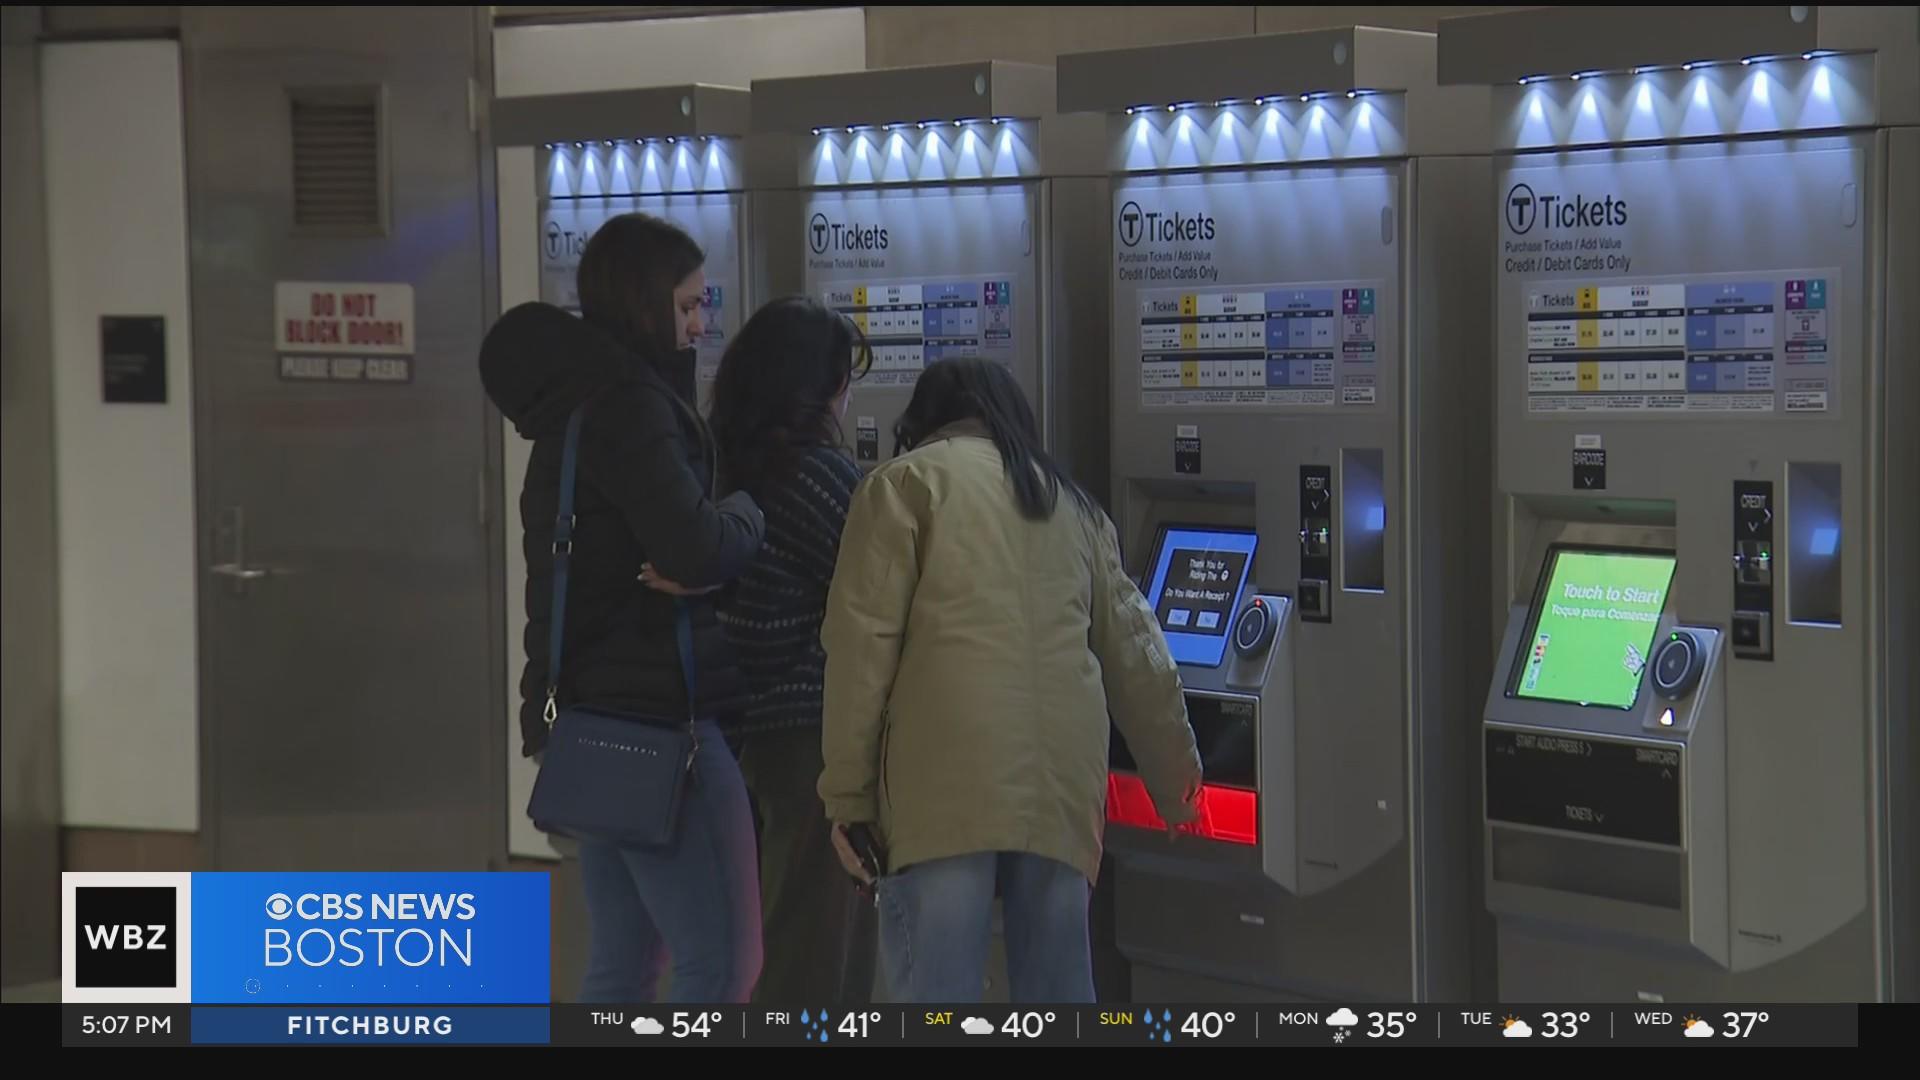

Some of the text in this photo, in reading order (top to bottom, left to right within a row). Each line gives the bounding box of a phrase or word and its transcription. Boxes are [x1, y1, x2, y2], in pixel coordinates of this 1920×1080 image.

[1539, 194, 1628, 229] Tickets
[1145, 211, 1216, 242] Tickets
[831, 222, 889, 251] Tickets
[1504, 241, 1542, 253] Purchase
[1544, 239, 1573, 252] Tickets
[1580, 238, 1597, 250] Add
[1599, 237, 1622, 250] Value
[1149, 251, 1173, 262] Tickets
[1178, 251, 1192, 261] Add
[1193, 250, 1212, 261] Value
[1505, 257, 1536, 273] Credit
[1544, 256, 1572, 272] Debit
[1573, 255, 1605, 271] Cards
[1606, 253, 1631, 273] Only
[1118, 268, 1144, 281] Credit
[1149, 267, 1172, 280] Debit
[1172, 265, 1198, 280] Cards
[1198, 265, 1219, 282] Only
[311, 293, 376, 317] DO NOT
[1152, 301, 1179, 312] Tickets
[1542, 293, 1575, 307] Tickets
[286, 319, 403, 345] BLOCK DOOR!
[1574, 452, 1604, 466] BARCODE
[1740, 494, 1766, 508] CREDIT
[1189, 558, 1205, 569] Thank
[1206, 560, 1216, 569] You
[1207, 571, 1218, 582] The
[1165, 587, 1174, 597] Do
[1175, 588, 1184, 598] You
[1185, 589, 1200, 599] Want
[1200, 590, 1205, 599] A
[1563, 583, 1660, 604] Touch to Start
[1551, 604, 1581, 620] Toque
[1582, 607, 1606, 620] para
[1516, 733, 1536, 748] START
[1536, 737, 1556, 751] AUDIO
[1557, 739, 1578, 754] PRESS
[1565, 804, 1592, 822] TICKETS
